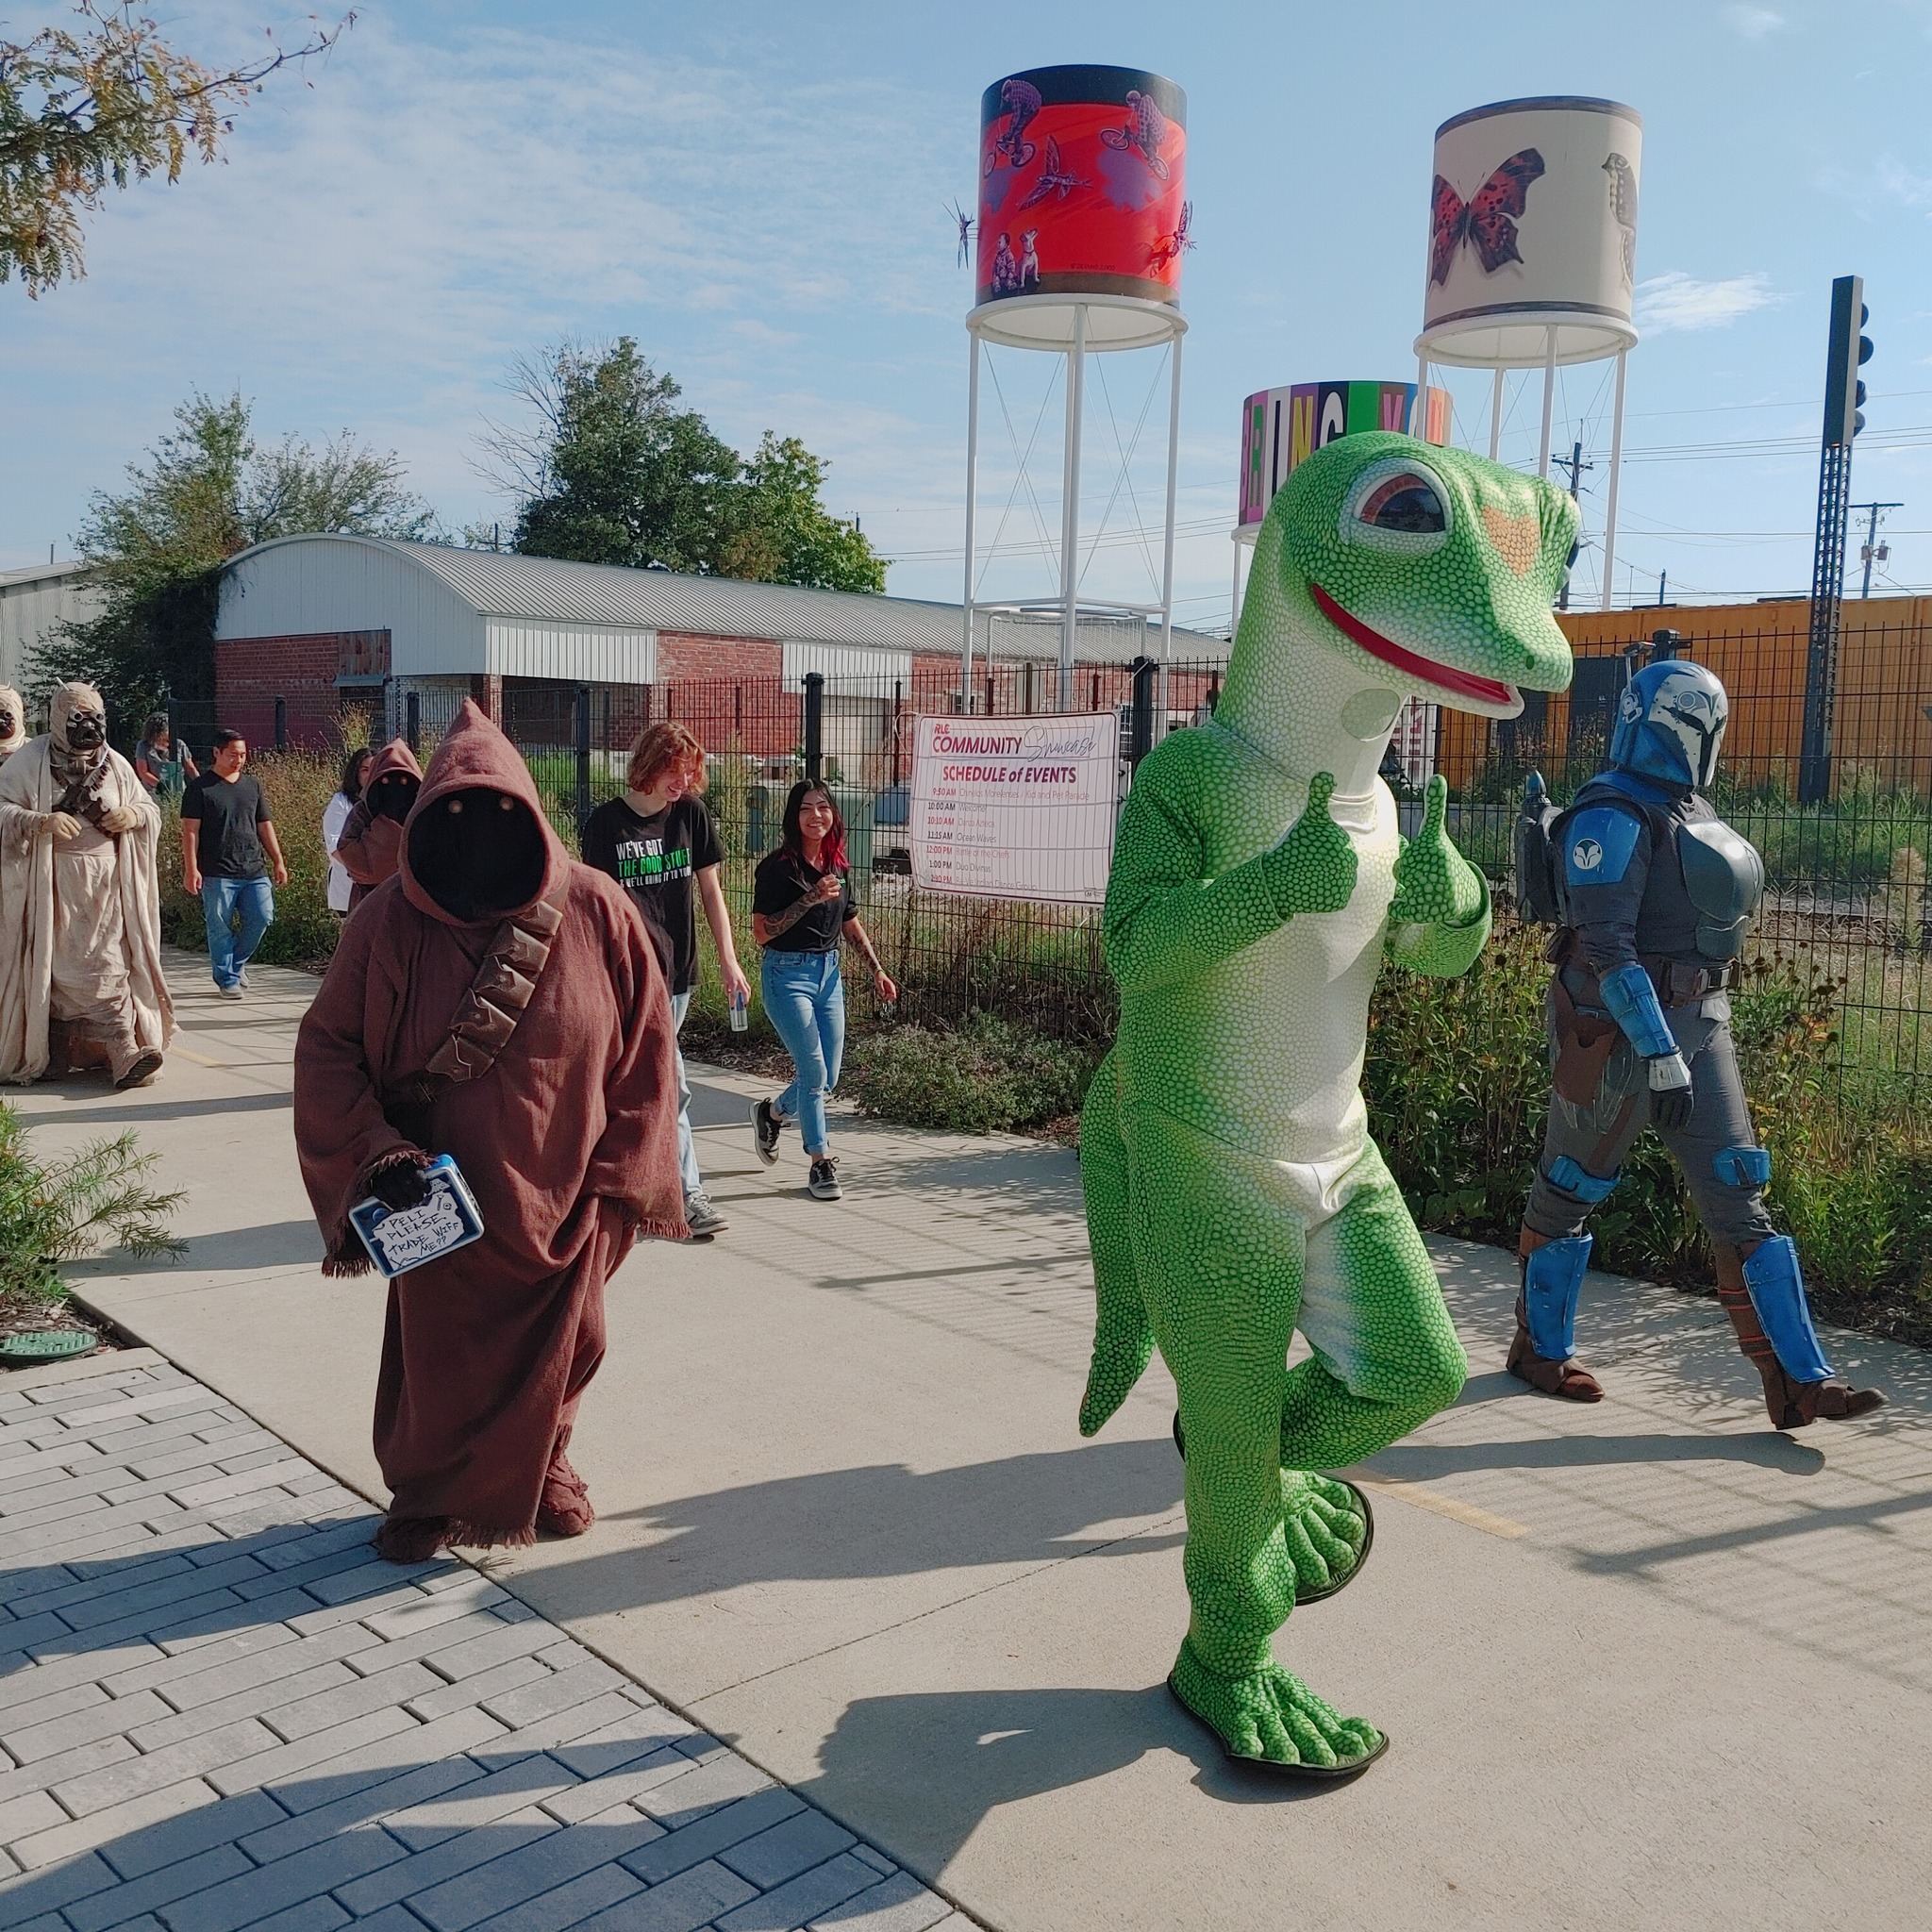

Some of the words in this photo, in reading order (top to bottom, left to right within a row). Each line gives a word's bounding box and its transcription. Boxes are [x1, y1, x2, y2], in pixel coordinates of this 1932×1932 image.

[934, 723, 950, 734] RLC
[932, 736, 1022, 754] COMMUNITY
[1024, 725, 1096, 762] Showcase
[943, 765, 1007, 782] SCHEDULE
[1008, 767, 1024, 782] of
[1024, 766, 1076, 783] EVENTS
[945, 788, 957, 796] AM
[1038, 791, 1051, 800] and
[1065, 791, 1090, 801] Parade
[928, 802, 944, 810] 10:00
[944, 803, 956, 811] AM
[927, 816, 942, 825] 10:10
[943, 817, 955, 825] AM
[927, 831, 941, 840] 11:15
[957, 832, 975, 841] Ocean
[976, 834, 996, 843] Waves
[616, 840, 645, 860] WE'VE
[645, 839, 663, 857] GOT
[926, 844, 942, 854] 12:00
[943, 846, 953, 855] PM
[618, 858, 638, 877] THE
[641, 856, 663, 874] GOOD
[664, 847, 691, 871] STUFF
[929, 859, 941, 869] 1:00
[942, 860, 953, 869] PM
[956, 861, 968, 871] Duo
[663, 872, 670, 882] IT
[671, 869, 678, 880] TO
[943, 875, 953, 884] PM
[390, 1209, 426, 1229] PELI
[389, 1235, 429, 1256] TRADE
[433, 1222, 458, 1237] WIFF
[420, 1236, 447, 1257] ME??
